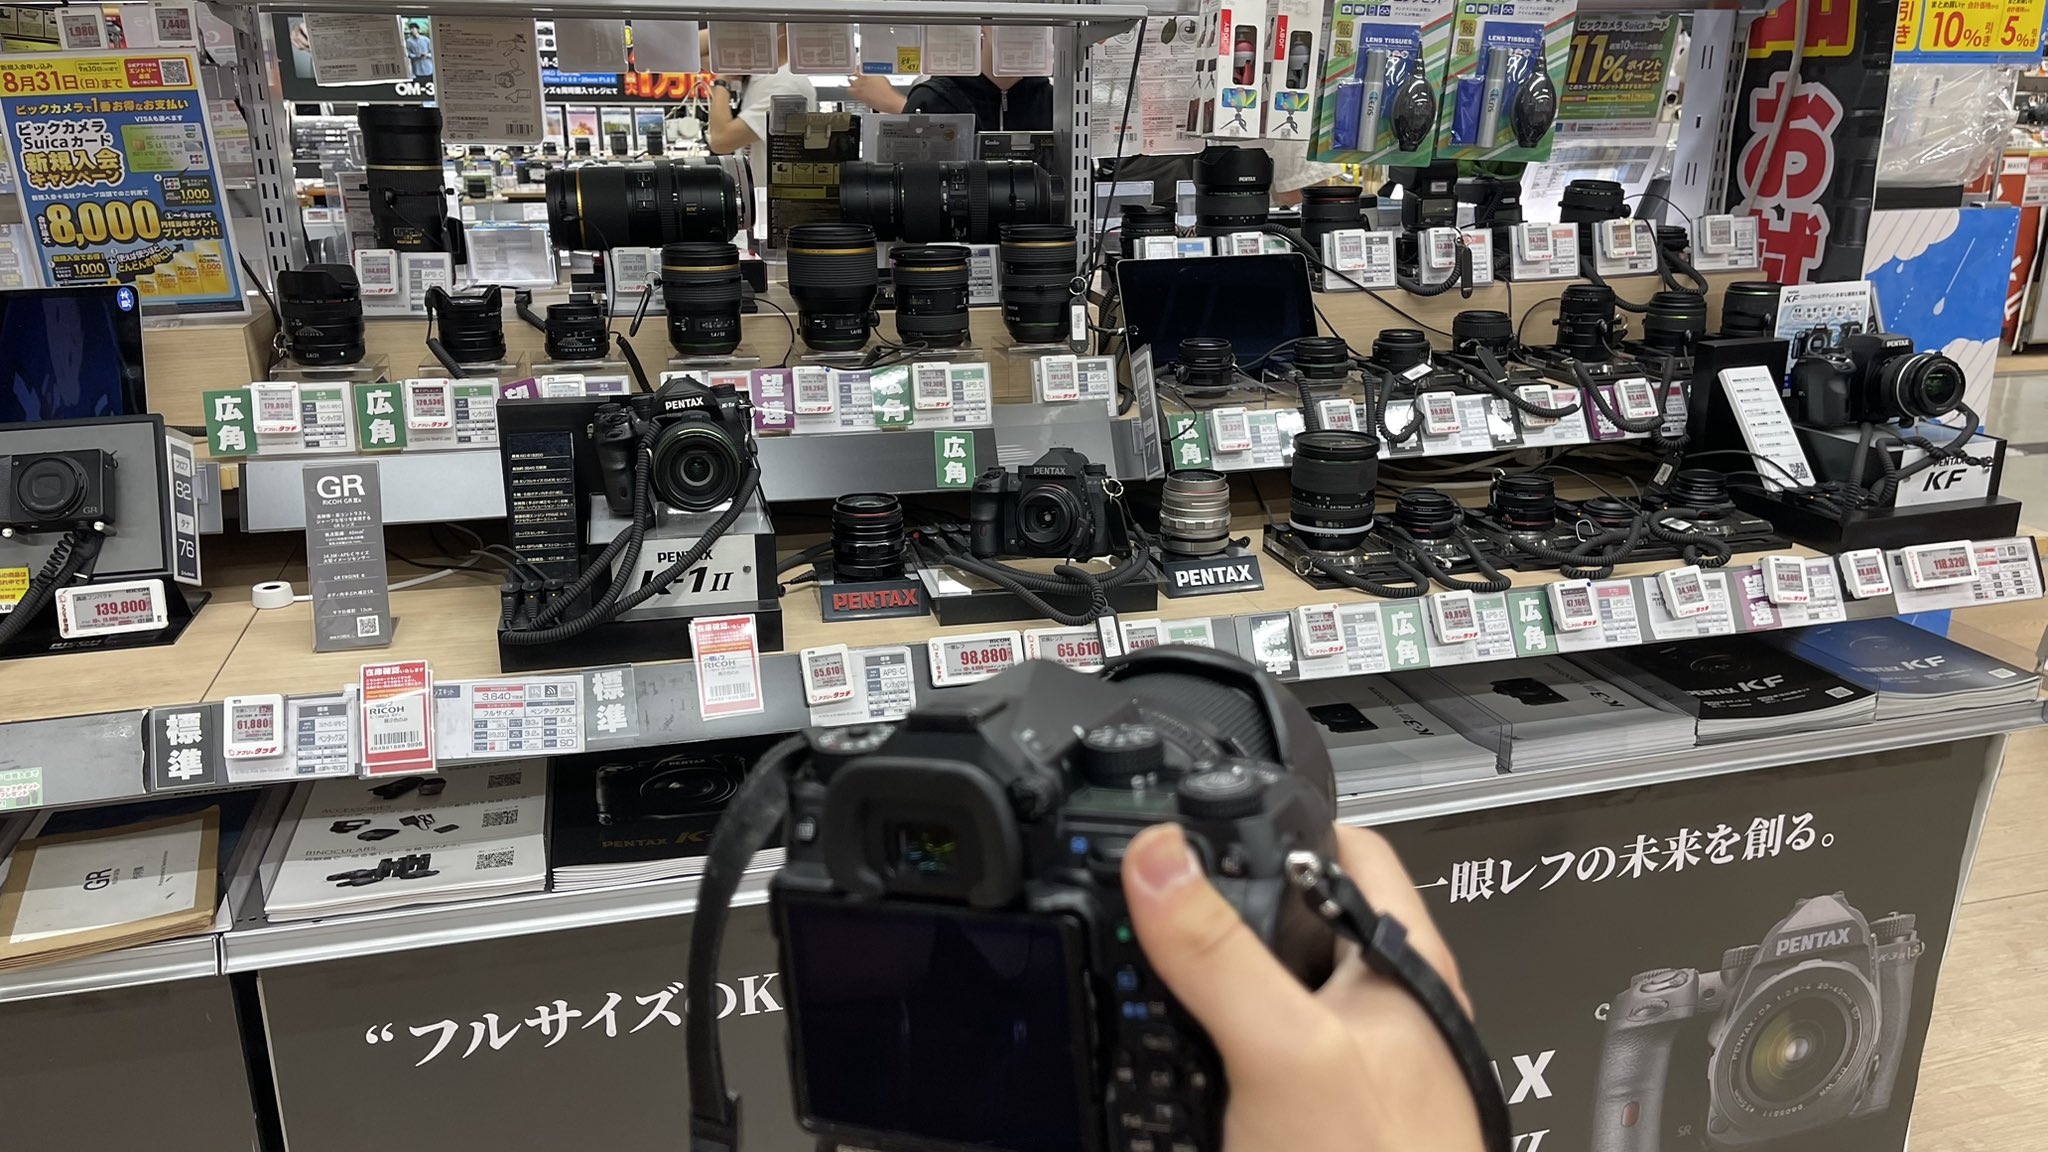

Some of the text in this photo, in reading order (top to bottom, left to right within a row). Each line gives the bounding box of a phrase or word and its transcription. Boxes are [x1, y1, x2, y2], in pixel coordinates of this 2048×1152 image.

[162, 19, 187, 30] 7,440
[1578, 19, 1623, 32] ビックカメラ
[1932, 11, 1995, 49] 10% 引き
[2000, 16, 2031, 48] 5%
[1223, 23, 1231, 44] JOBY
[1278, 27, 1287, 49] JOBY
[1365, 36, 1413, 46] LENS TISSUES
[1487, 34, 1536, 44] LENS TISSUES
[1568, 34, 1627, 84] 11%
[1627, 57, 1662, 71] ポイント
[129, 68, 158, 76] エントリー
[1624, 70, 1661, 83] サービス
[3, 71, 123, 94] 8月31日(日)まで
[394, 82, 436, 97] OM-3
[15, 97, 190, 117] ビックカメラで1番お得なお支払い
[18, 121, 105, 138] ビックカメラ
[24, 150, 122, 173] 新規入会
[29, 169, 122, 188] キャンペーン
[180, 188, 210, 200] 1,000
[46, 199, 161, 248] 8,000
[73, 263, 105, 275] 1,000
[1784, 294, 1801, 304] KF
[1886, 339, 1911, 350] PENTAX
[664, 397, 706, 412] PENTAX
[213, 395, 248, 454] 広角
[365, 388, 398, 449] 広角
[1177, 417, 1202, 465] 広角
[944, 436, 968, 491] 広角
[1032, 466, 1067, 477] PENTAX
[316, 474, 367, 499] GR
[1922, 468, 1968, 492] KF
[173, 479, 193, 501] 82
[322, 498, 343, 506] RICOH
[82, 506, 98, 516] GR
[177, 537, 196, 560] 76
[657, 549, 714, 563] PENX
[708, 571, 734, 592] II
[1175, 562, 1255, 587] PENTAX
[94, 599, 147, 617] 139,800
[832, 588, 920, 612] PENTAX
[1517, 596, 1548, 652] 広角
[1390, 610, 1420, 666] 広角
[960, 647, 1007, 667] 98,880
[1057, 641, 1100, 658] 65,610
[704, 660, 736, 670] RICOH
[1898, 655, 1947, 670] KF
[365, 666, 425, 678] 在庫確認いたします
[1736, 674, 1786, 693] KF
[481, 692, 511, 702] 3,640
[591, 670, 630, 734] 標準
[369, 705, 405, 716] RICOH
[482, 709, 516, 719] フルサイズ
[530, 706, 573, 716] ペンタックスK
[236, 717, 270, 730] 61,880
[165, 712, 203, 780] 標準
[559, 739, 575, 748] SD
[669, 758, 707, 767] PENTAX
[321, 804, 393, 815] ACCESSORIES
[304, 844, 377, 857] BINOCULARS
[601, 837, 669, 849] PENTAX
[1411, 811, 1835, 904] 一眼レフの未来を創る。
[83, 867, 113, 892] GR
[1774, 926, 1853, 956] PENTAX
